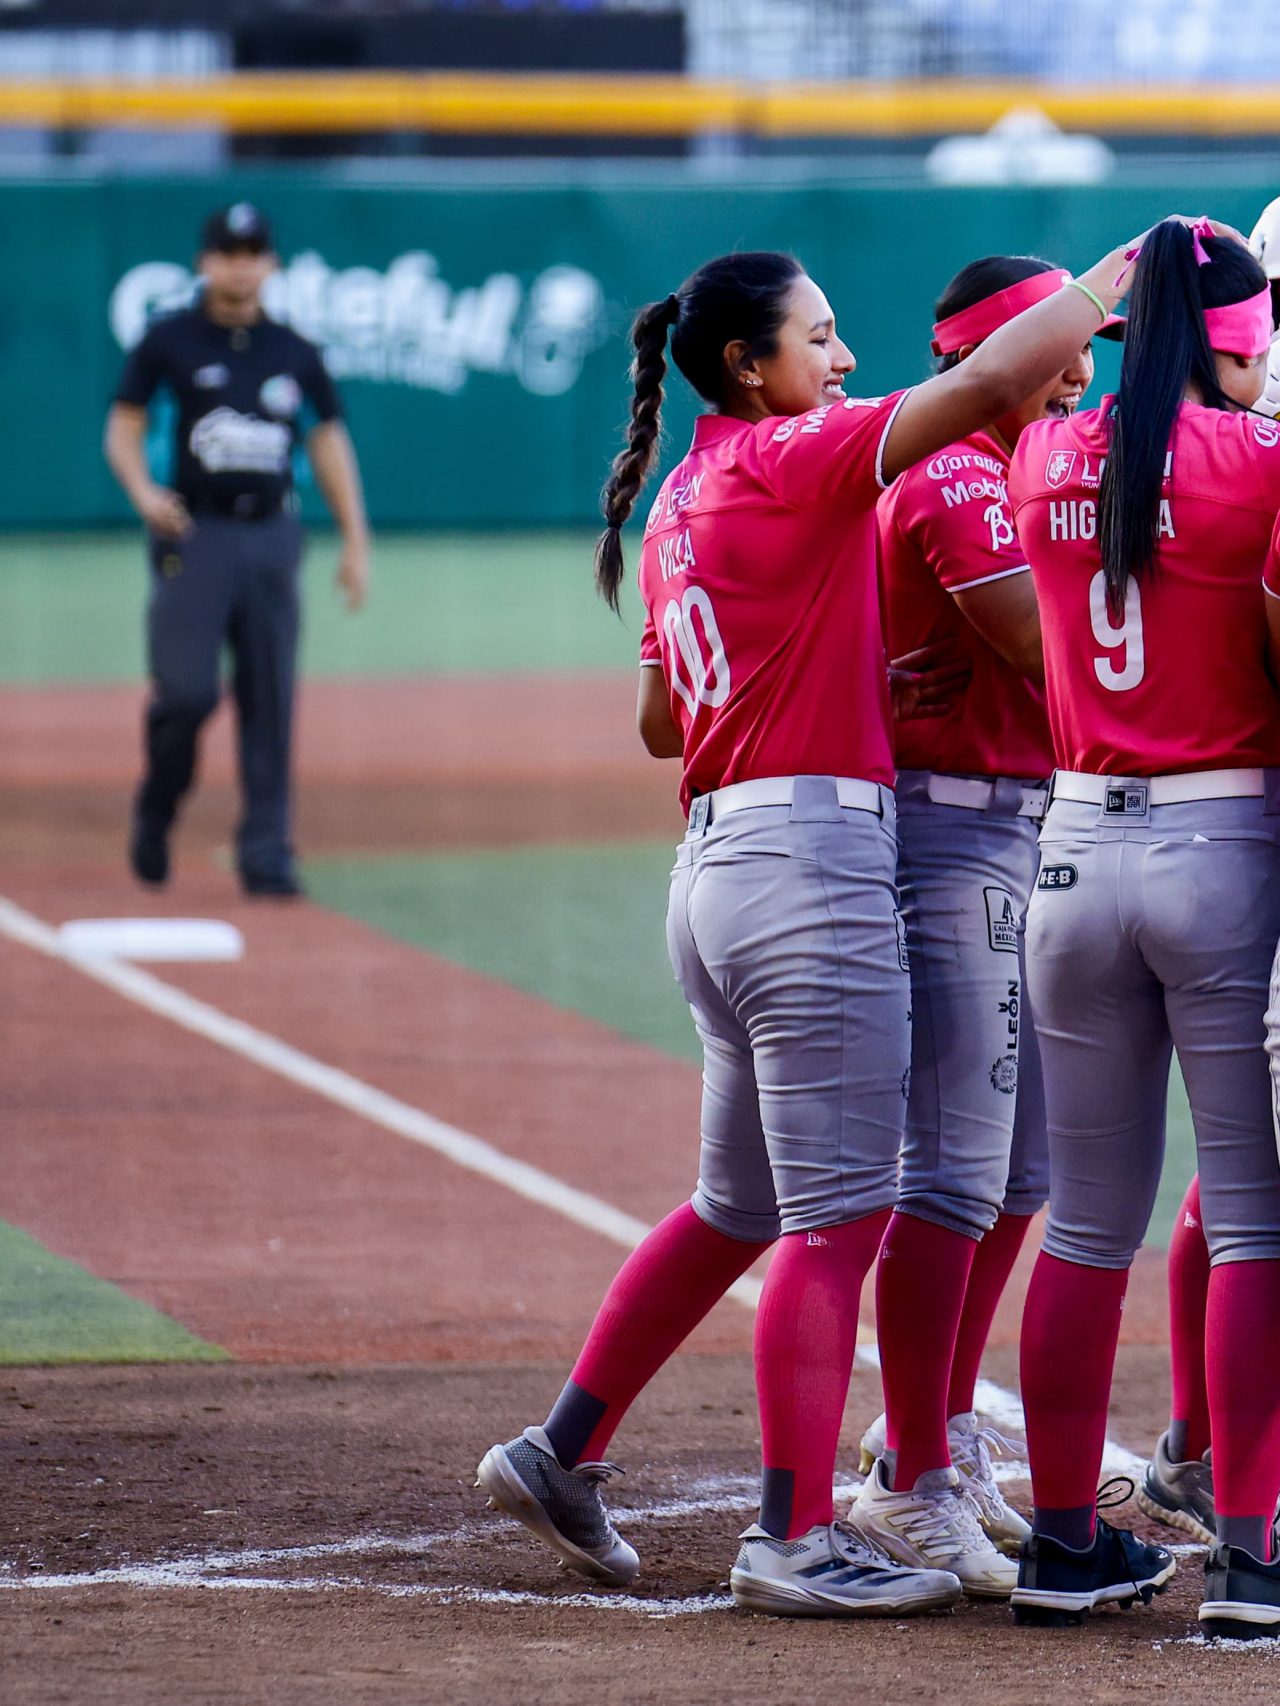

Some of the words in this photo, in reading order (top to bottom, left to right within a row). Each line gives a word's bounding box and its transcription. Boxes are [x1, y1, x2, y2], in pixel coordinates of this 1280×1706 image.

[108, 249, 521, 374] Gteful
[926, 454, 1004, 480] Corona
[940, 477, 1009, 509] Mobil
[983, 500, 1014, 552] B
[1049, 499, 1176, 541] HIGA
[657, 527, 696, 583] VILLA
[663, 585, 731, 720] 00
[1089, 568, 1145, 692] 9
